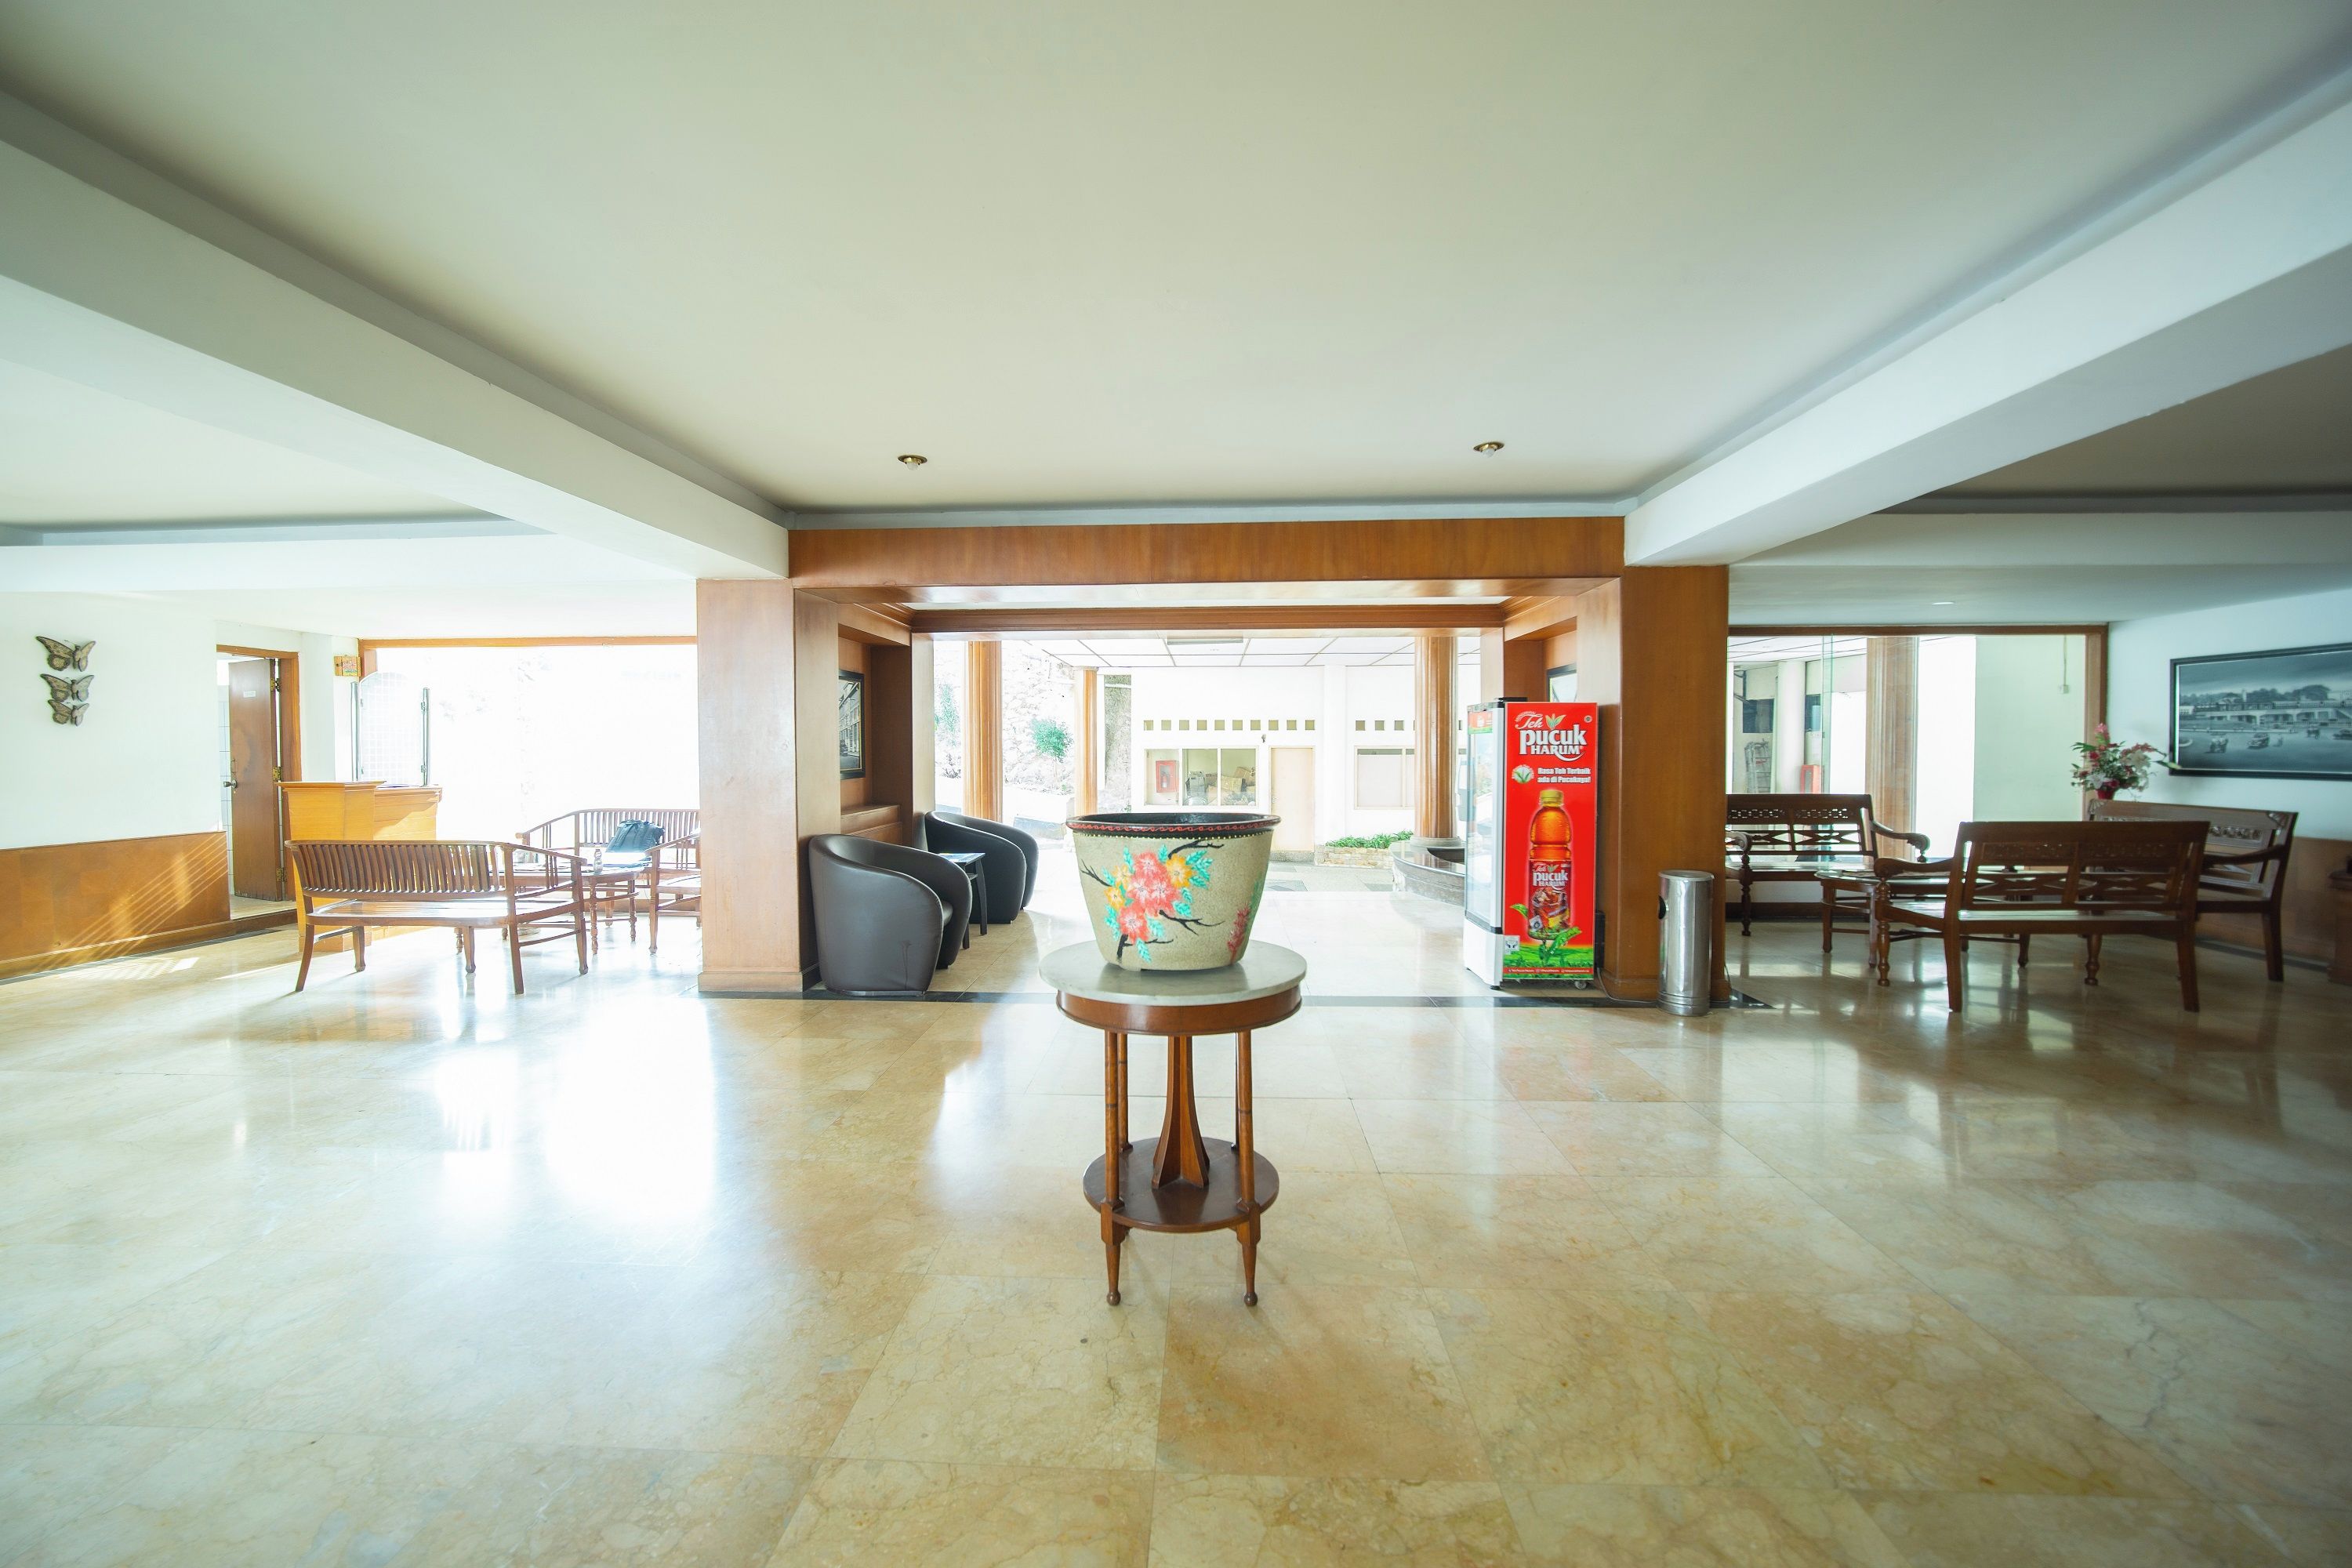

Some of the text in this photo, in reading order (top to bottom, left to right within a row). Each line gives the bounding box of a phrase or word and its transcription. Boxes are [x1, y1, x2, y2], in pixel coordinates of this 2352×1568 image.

[1515, 713, 1544, 729] Teh
[1519, 724, 1588, 755] pucuk
[1530, 745, 1582, 757] HARUM
